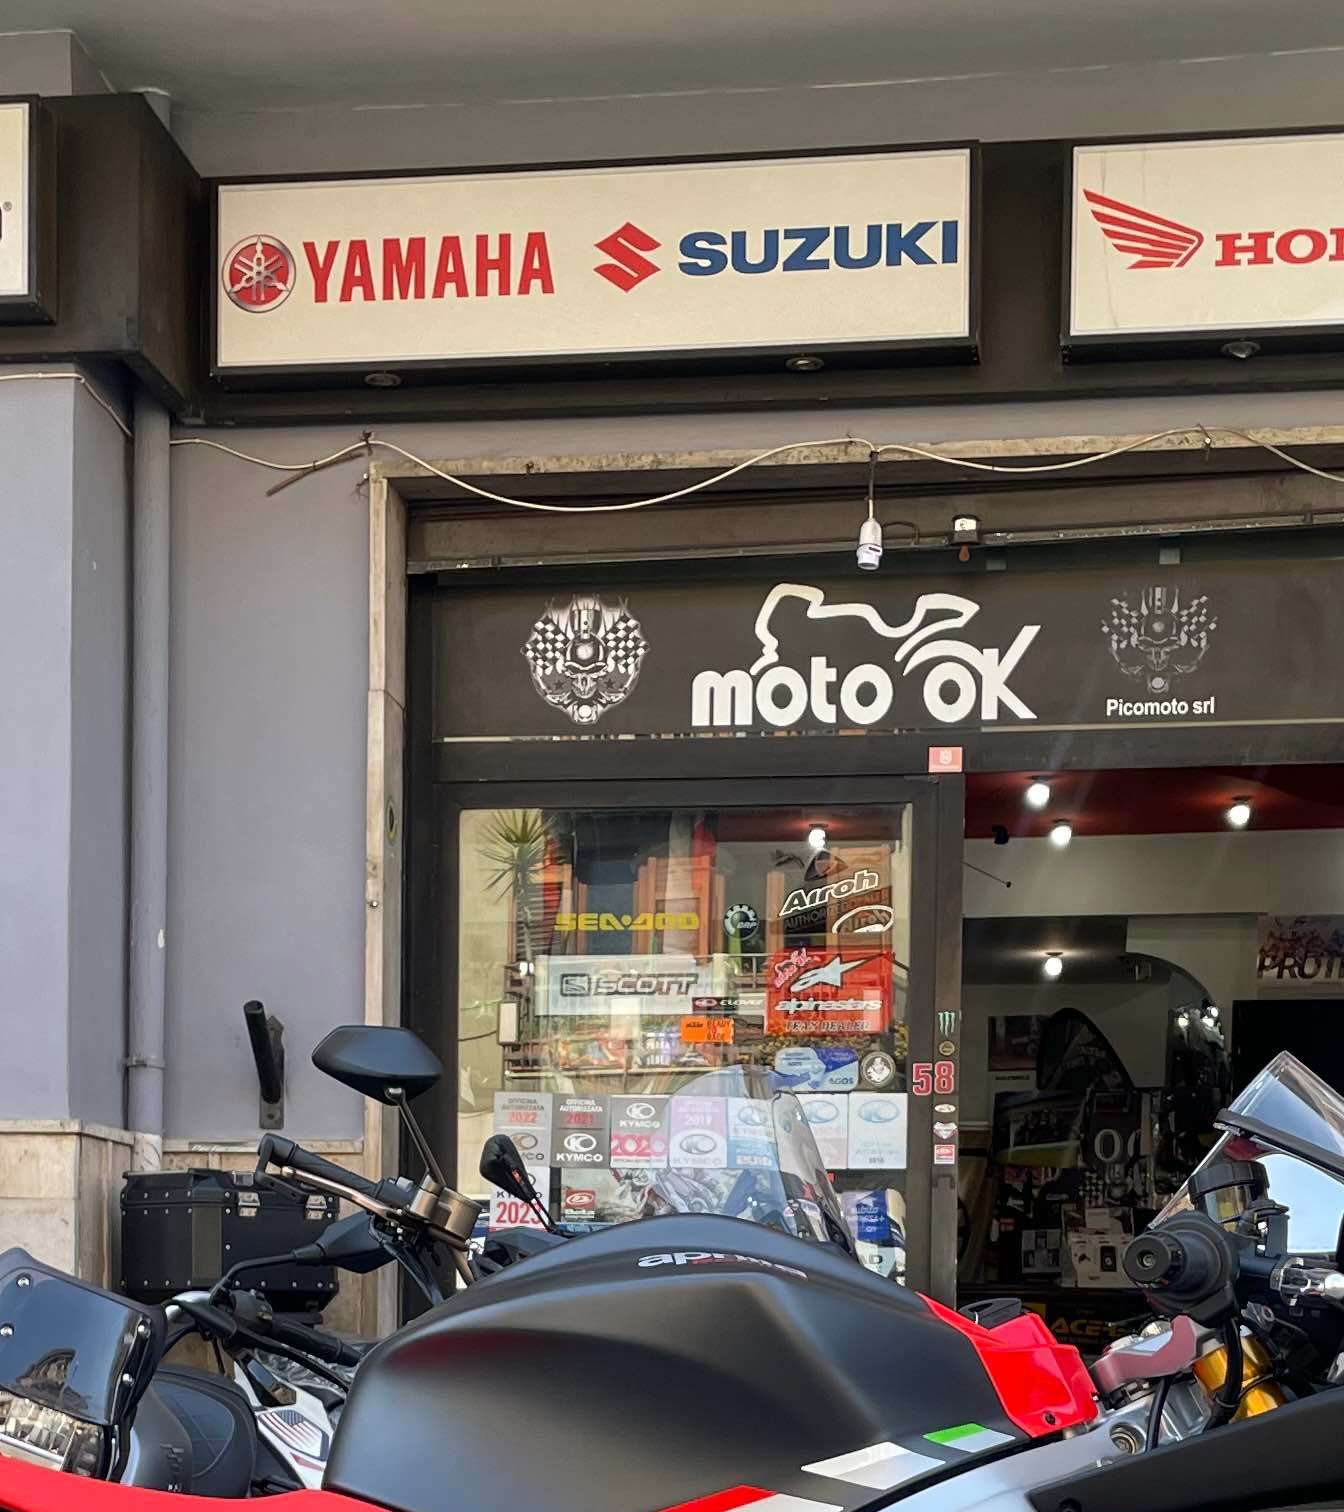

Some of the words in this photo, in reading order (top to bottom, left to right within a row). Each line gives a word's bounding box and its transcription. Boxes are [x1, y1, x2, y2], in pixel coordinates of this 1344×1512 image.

[677, 220, 959, 277] SUZUKI
[302, 231, 556, 304] YAMAHA
[690, 655, 895, 729] moto
[922, 623, 1043, 723] OK
[1104, 697, 1186, 716] Picomoto
[1191, 696, 1216, 715] srl
[592, 972, 699, 996] SCOTT
[912, 1060, 955, 1096] 58
[619, 1120, 661, 1129] KYMCO
[556, 1152, 604, 1162] KYMCO
